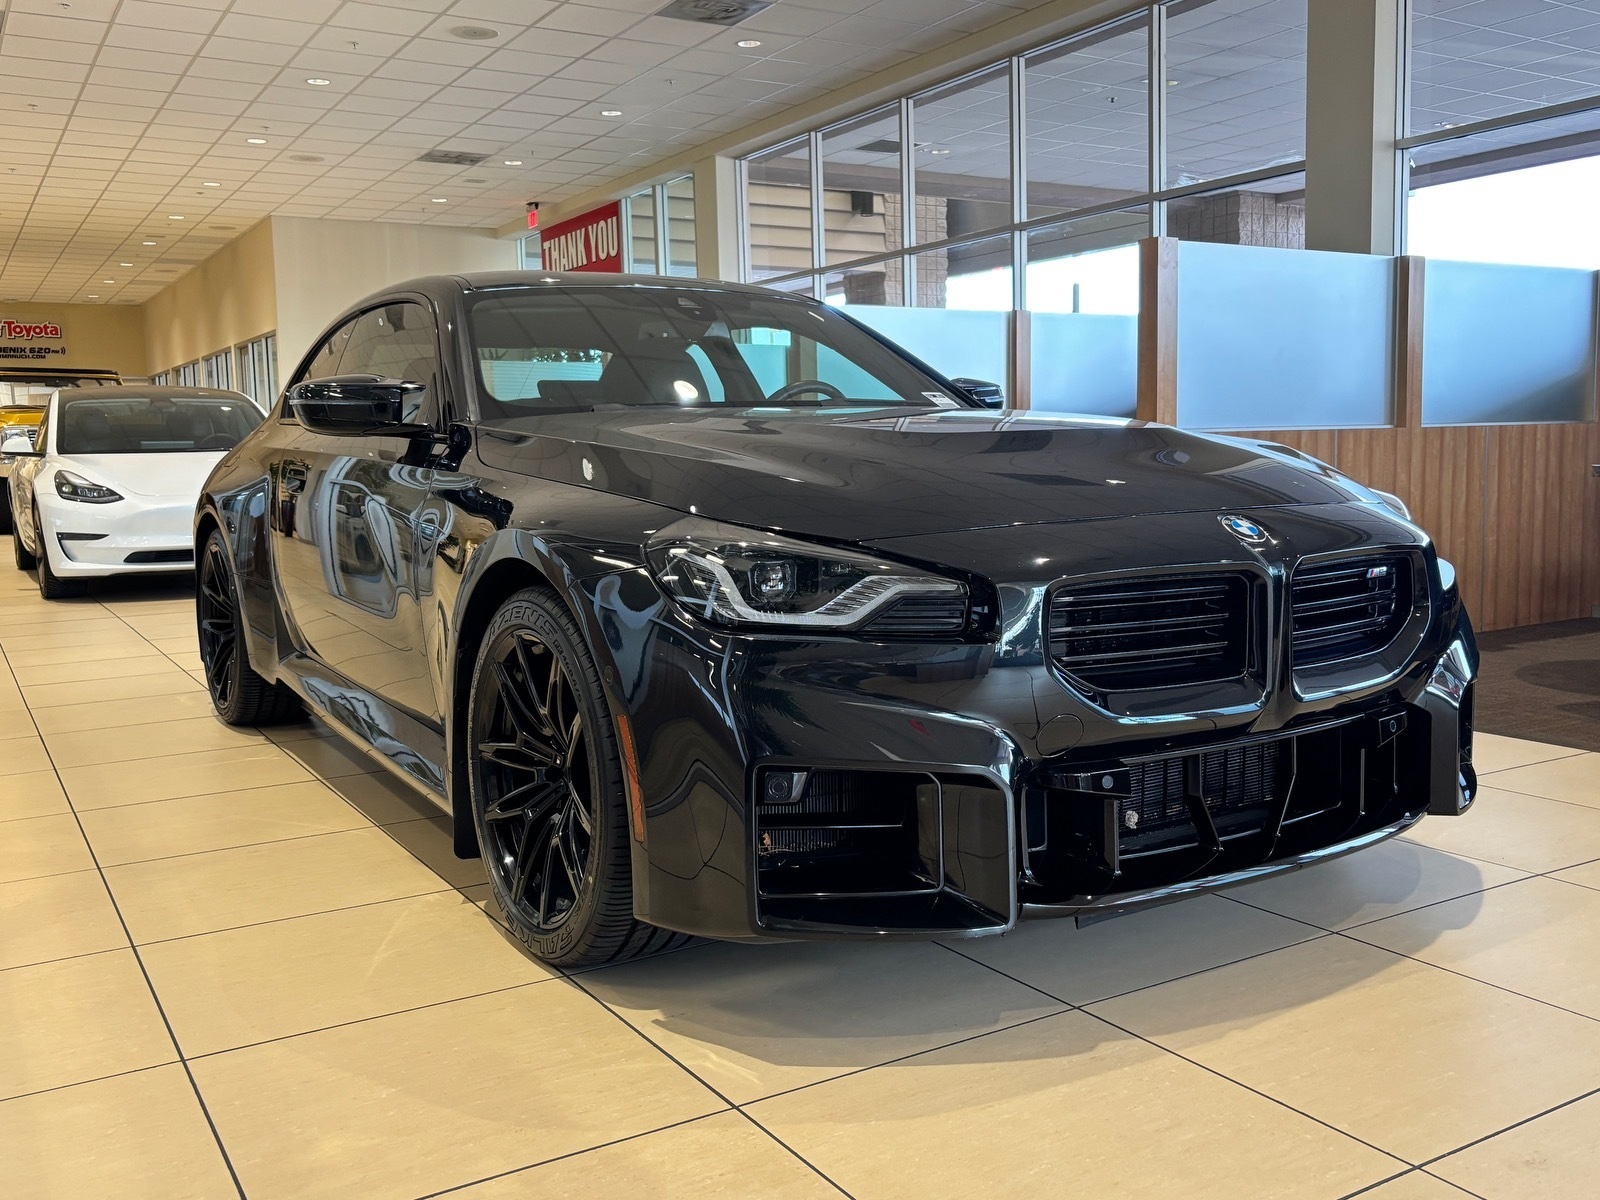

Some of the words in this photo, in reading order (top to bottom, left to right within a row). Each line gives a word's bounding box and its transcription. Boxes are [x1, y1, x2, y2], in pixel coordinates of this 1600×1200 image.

[543, 227, 587, 272] THANK
[588, 216, 618, 263] YOU
[3, 320, 60, 338] Toyota
